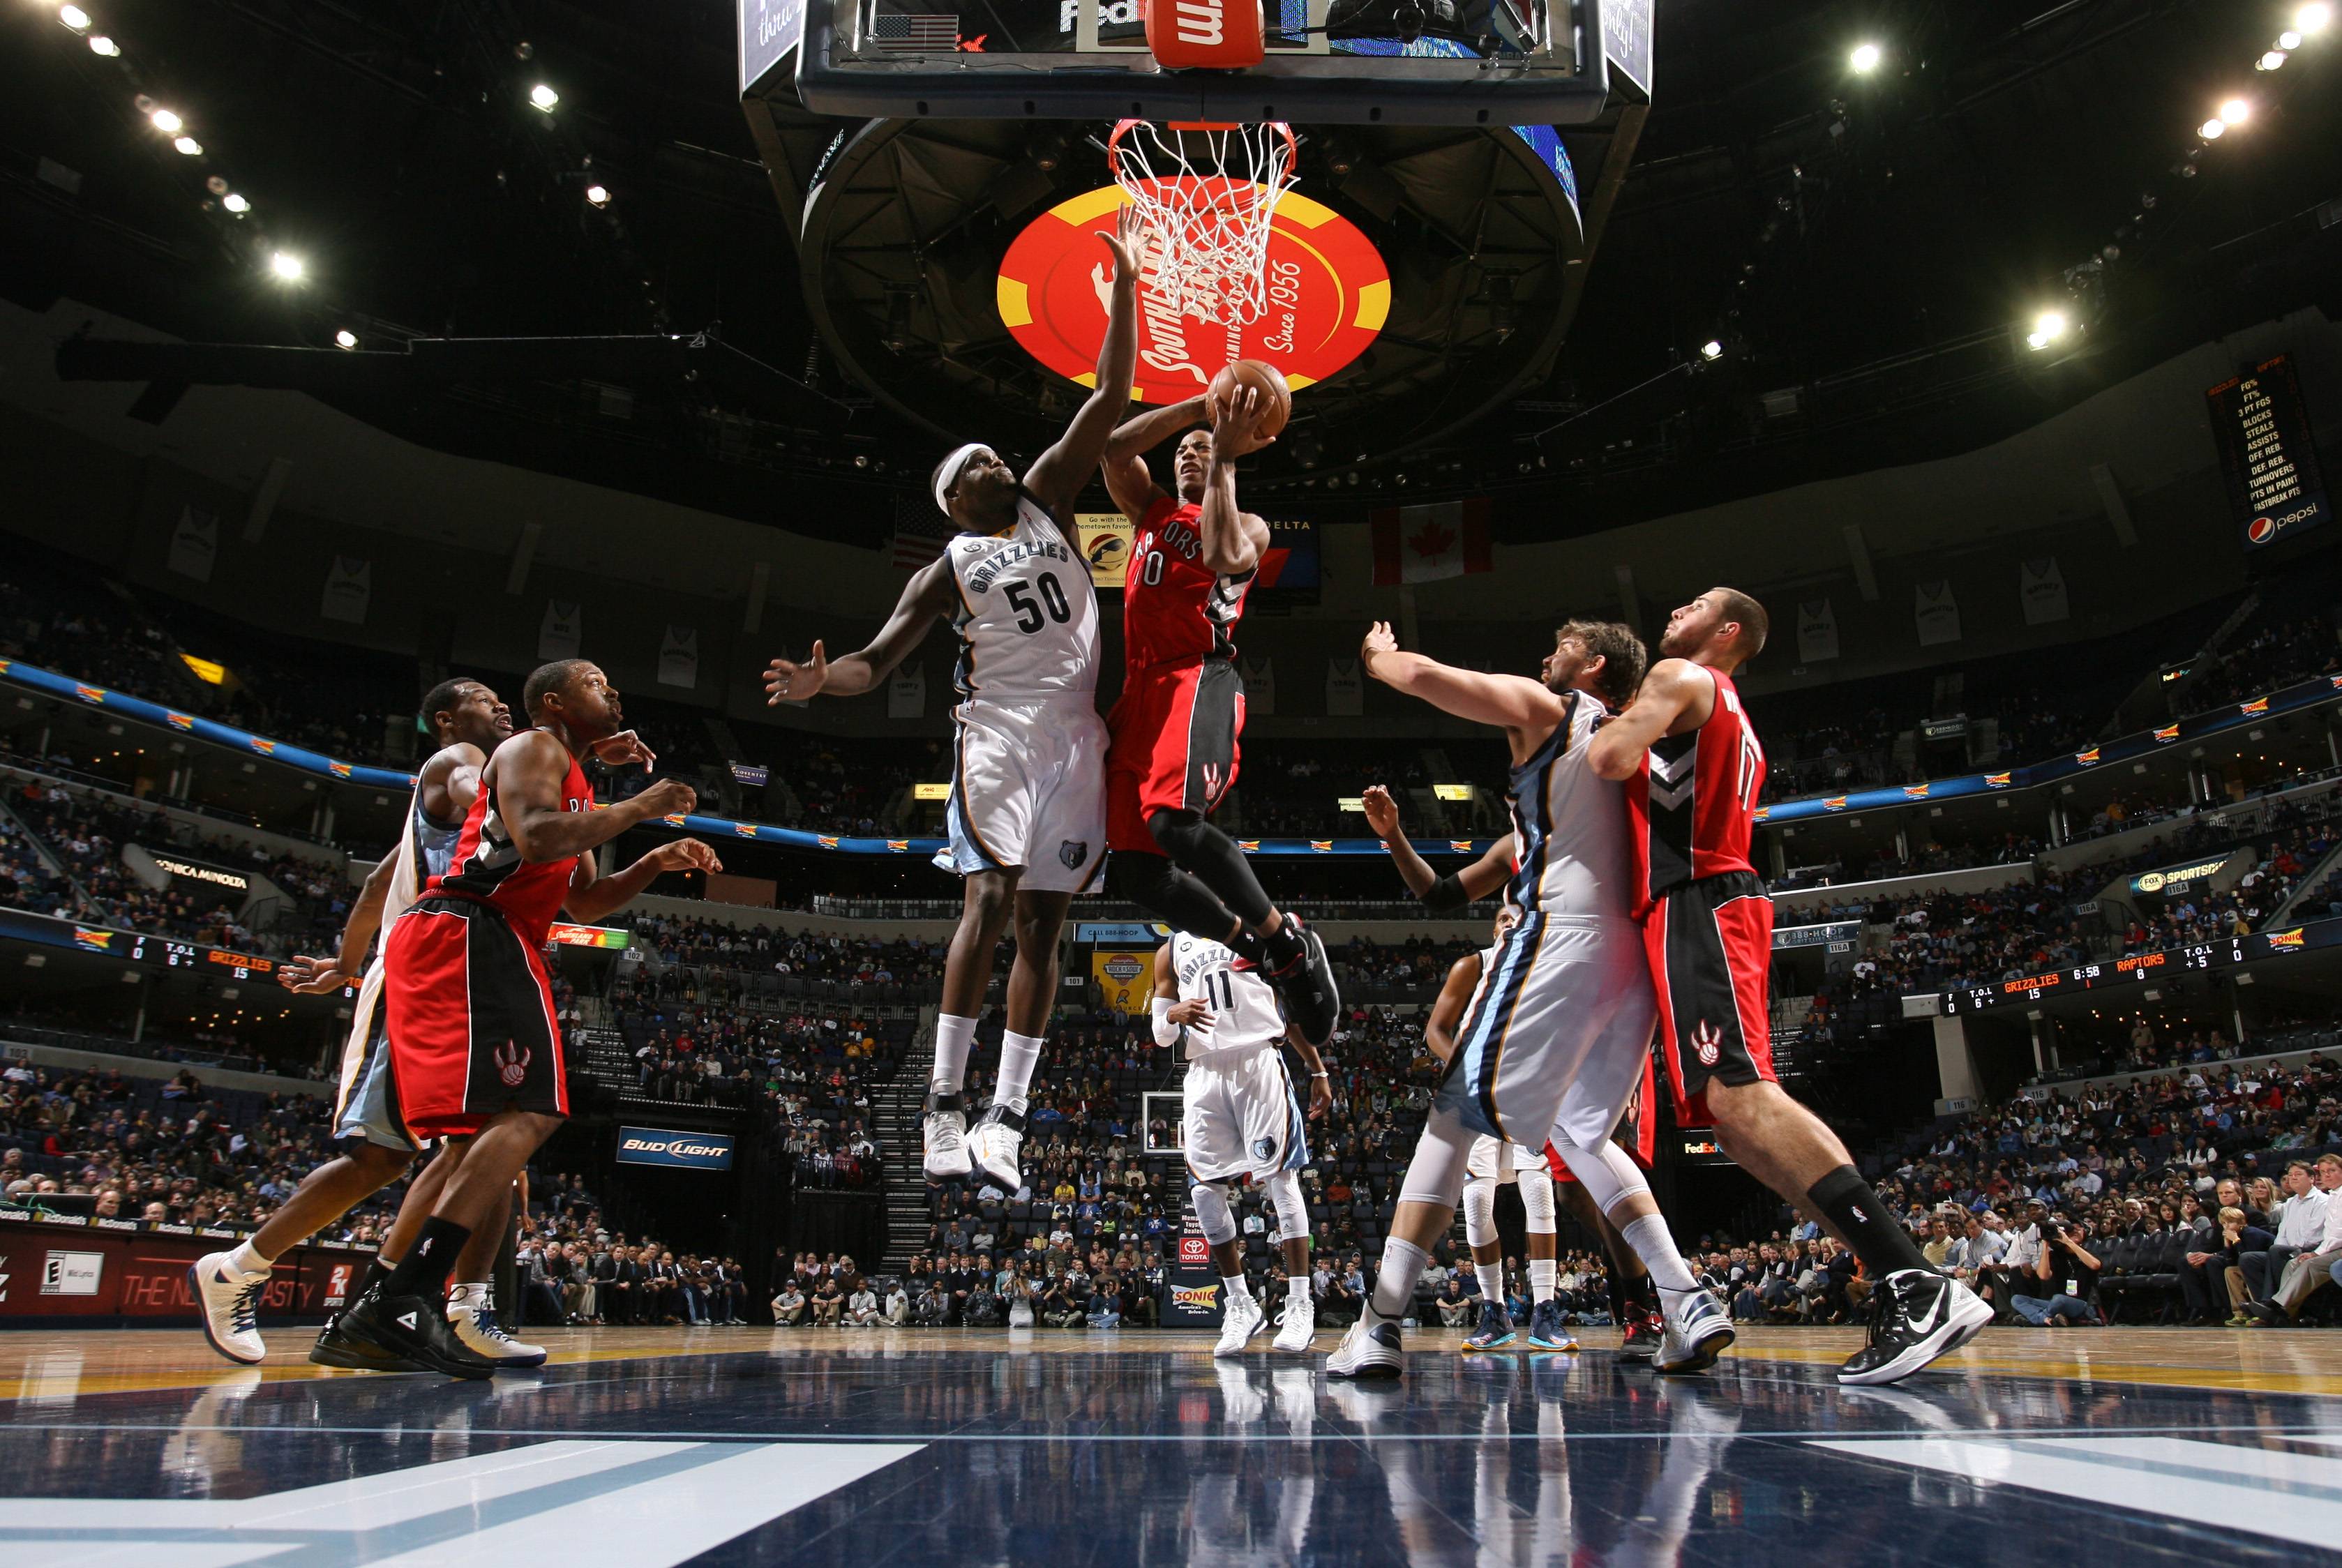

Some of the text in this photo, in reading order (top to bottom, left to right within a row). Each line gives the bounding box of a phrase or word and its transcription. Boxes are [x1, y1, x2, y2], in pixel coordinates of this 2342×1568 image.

[1270, 259, 1301, 310] 1956
[1263, 312, 1296, 354] Since
[2238, 396, 2271, 418] 3 PT FGS
[2243, 409, 2272, 428] BLOCKS
[2246, 421, 2274, 439] STEALS
[2247, 431, 2279, 451] ASSISTS
[2265, 442, 2283, 456] REB.
[2268, 455, 2286, 469] REB.
[2249, 463, 2295, 489] TURNOVERS
[2250, 474, 2299, 502] PTS IN PAINT
[2254, 486, 2302, 513] FASTBREAK PTS
[2277, 502, 2318, 530] pepsi
[970, 539, 1069, 594] GRIZZLIES
[1002, 571, 1072, 635] 50
[1752, 809, 1769, 817] ONIC
[156, 859, 197, 878] ONICA
[2144, 877, 2160, 885] FOX
[2168, 884, 2188, 894] 116A
[1831, 943, 1849, 952] 116A
[2270, 932, 2302, 946] SONIC
[628, 952, 640, 960] 102
[2117, 953, 2165, 972] RAPTORS
[2198, 956, 2207, 968] 5
[2233, 949, 2242, 962] 0
[234, 967, 248, 979] 15
[1180, 948, 1240, 986] GRIZZLI
[2073, 966, 2100, 980] 6:58
[2136, 968, 2145, 980] 8
[1205, 970, 1234, 1011] 11
[2004, 974, 2059, 993] GRIZZLIES
[2029, 988, 2041, 1000] 15
[1948, 1003, 1955, 1013] 0
[1975, 998, 1982, 1009] 6
[2032, 1090, 2044, 1100] 116
[1953, 1100, 1965, 1110] 116
[623, 1138, 728, 1157] BUD LIGHT
[1684, 1142, 1724, 1154] FedExF
[47, 1260, 59, 1283] E
[331, 1266, 349, 1296] 2K
[124, 1275, 315, 1309] THE NE ASTY
[1174, 1291, 1215, 1302] SONIC
